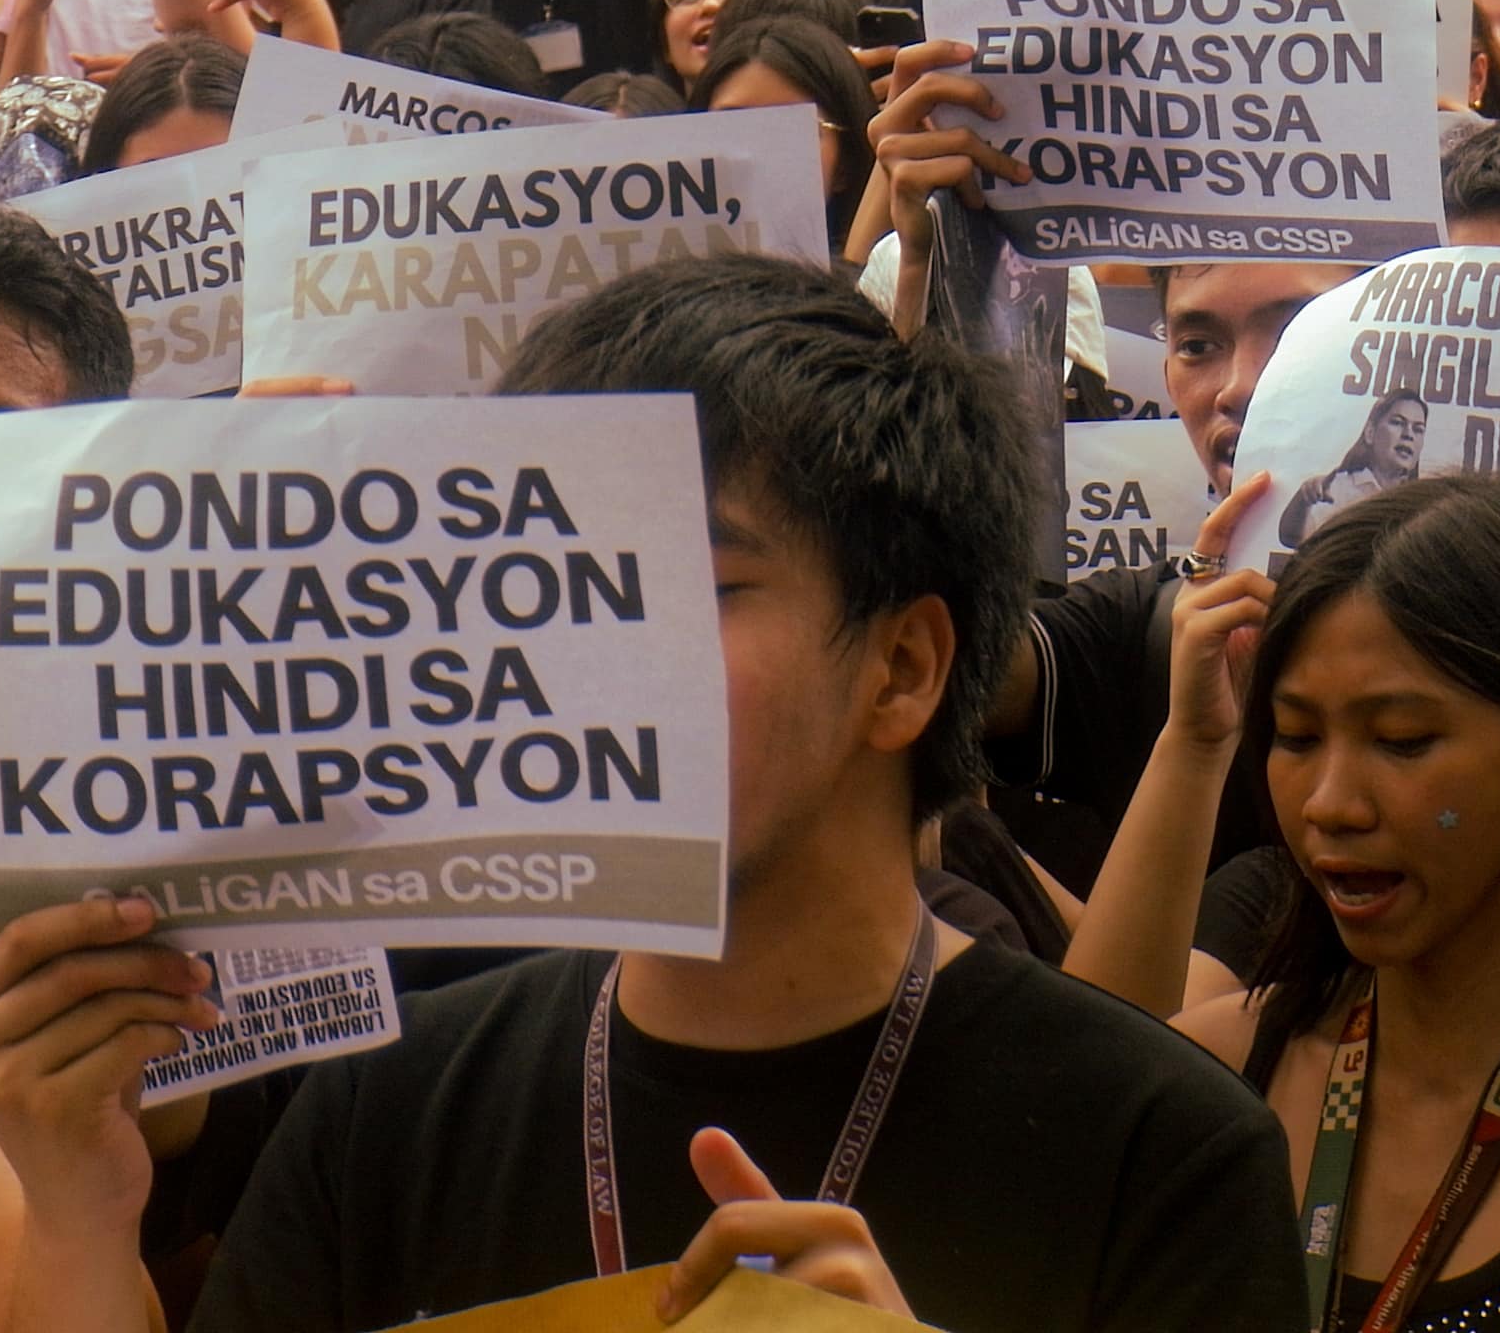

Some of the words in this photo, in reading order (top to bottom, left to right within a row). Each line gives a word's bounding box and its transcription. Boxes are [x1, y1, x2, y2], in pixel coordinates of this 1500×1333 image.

[971, 27, 1382, 84] EDUKASYON
[1040, 84, 1223, 140] HINDI
[1231, 94, 1321, 144] SA
[975, 137, 1391, 202] KORAPSYON
[307, 157, 744, 248] EDUKASYON,
[1208, 227, 1248, 252] sa
[1254, 223, 1352, 256] CSSP
[52, 469, 419, 553] PONDO
[438, 466, 580, 539] SA
[95, 653, 391, 741] HINDI
[409, 647, 553, 725] SA
[362, 871, 430, 905] sa
[438, 850, 598, 905] CSSP
